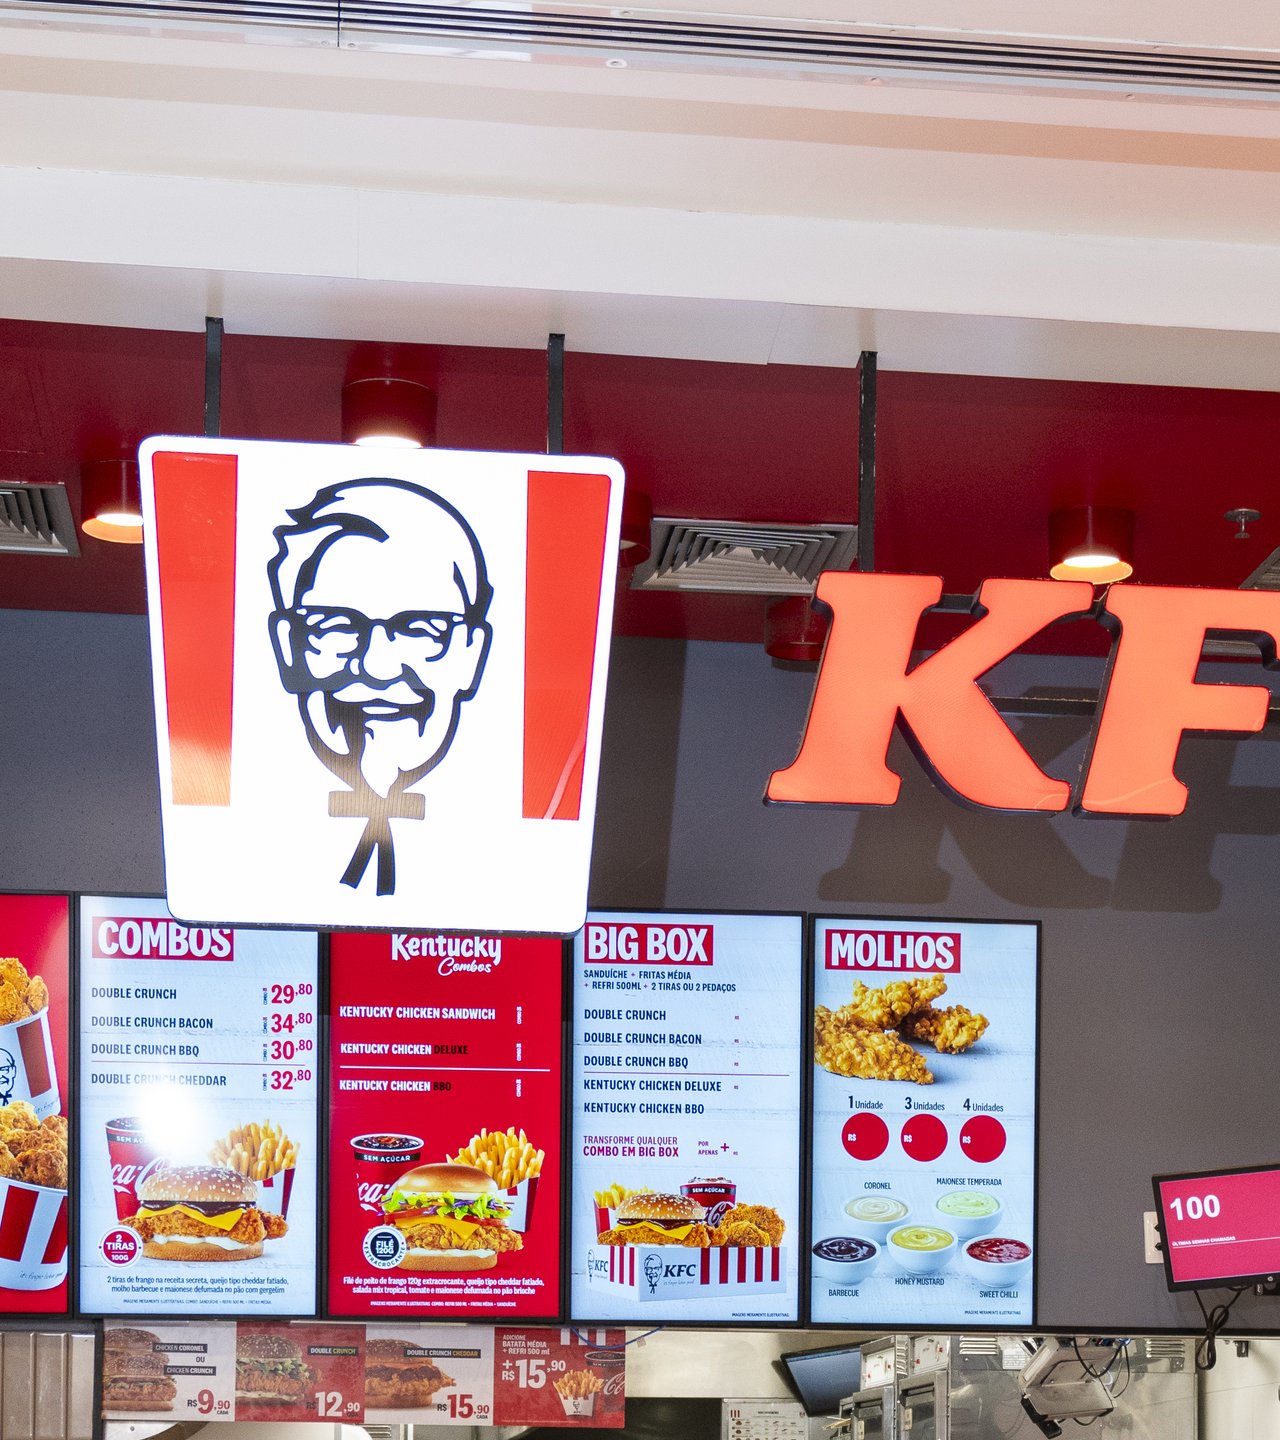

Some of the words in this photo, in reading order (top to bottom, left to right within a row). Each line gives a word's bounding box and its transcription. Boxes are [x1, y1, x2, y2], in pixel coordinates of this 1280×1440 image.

[98, 920, 231, 958] COMBOS
[588, 926, 638, 961] BIG
[647, 927, 708, 962] BOX
[391, 934, 501, 966] Kentucky
[831, 934, 954, 971] MOLHOS
[438, 957, 491, 976] Combos
[584, 969, 627, 978] SANDUÍCHE
[639, 971, 665, 979] FRITAS
[668, 970, 691, 980] MÉDIA
[271, 984, 312, 1004] 29,80
[340, 1006, 393, 1018] KENTUCKY
[396, 1007, 440, 1019] CHICKEN
[442, 1008, 495, 1020] SANDWICH
[92, 1016, 131, 1027] DOUBLE
[134, 1017, 176, 1028] CRUNCH
[179, 1018, 213, 1029] BACON
[271, 1013, 312, 1033] 34,80
[271, 1040, 313, 1060] 30,80
[341, 1043, 389, 1054] KENTUCKY
[392, 1044, 431, 1055] CHICKEN
[434, 1045, 468, 1055] DELUXE
[91, 1074, 131, 1084] DOUBLE
[179, 1075, 226, 1086] CHEDDAR
[271, 1070, 311, 1090] 32,80
[848, 1096, 853, 1108] 1
[855, 1101, 883, 1110] Unidade
[905, 1097, 912, 1109] 3
[914, 1102, 945, 1111] Unidades
[963, 1099, 971, 1111] 4
[973, 1103, 1004, 1112] Unidades
[584, 1136, 634, 1145] TRANSFORME
[637, 1137, 677, 1146] QUALQUER
[583, 1146, 618, 1156] COMBO
[622, 1147, 636, 1156] EM
[639, 1147, 655, 1157] BIG
[659, 1147, 679, 1157] BOX
[864, 1182, 891, 1190] CORONEL
[967, 1178, 1002, 1186] TEMPERADA
[1170, 1195, 1220, 1221] 100
[106, 1242, 134, 1250] TIRAS
[376, 1239, 394, 1248] FILÉ
[663, 1264, 696, 1277] KFC
[112, 1276, 124, 1284] tiras
[126, 1276, 134, 1284] de
[136, 1276, 154, 1286] frango
[186, 1277, 208, 1285] secreta,
[210, 1277, 227, 1287] queijo
[229, 1277, 240, 1286] tipo
[267, 1277, 289, 1285] fatiado,
[829, 1289, 859, 1297] BARBECUE
[516, 1359, 566, 1388] 15,90
[198, 1389, 230, 1415] 9,90
[315, 1392, 360, 1417] 12,90
[447, 1394, 489, 1418] 15,90
